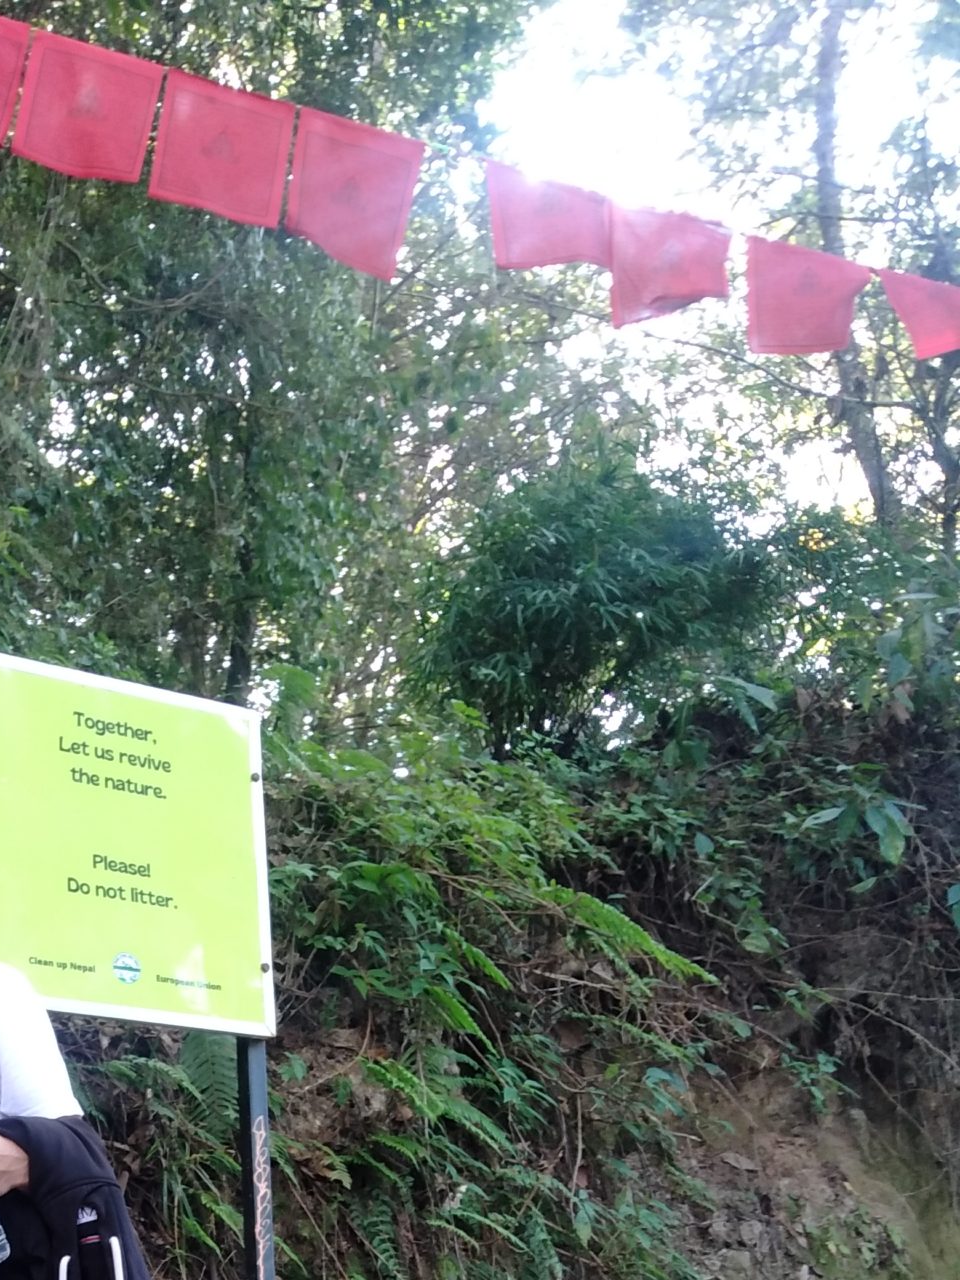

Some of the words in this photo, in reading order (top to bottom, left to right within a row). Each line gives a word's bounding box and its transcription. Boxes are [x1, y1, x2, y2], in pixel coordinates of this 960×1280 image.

[73, 711, 157, 745] Together,
[59, 736, 90, 757] Let
[94, 746, 115, 762] us
[119, 752, 172, 773] revive
[70, 767, 100, 786] the
[104, 777, 167, 800] nature.
[92, 854, 151, 878] Please!
[67, 877, 91, 895] Do
[95, 884, 127, 901] not
[130, 887, 178, 910] litter.
[28, 956, 54, 968] Clean
[56, 961, 68, 971] up
[69, 962, 96, 974] Nepal
